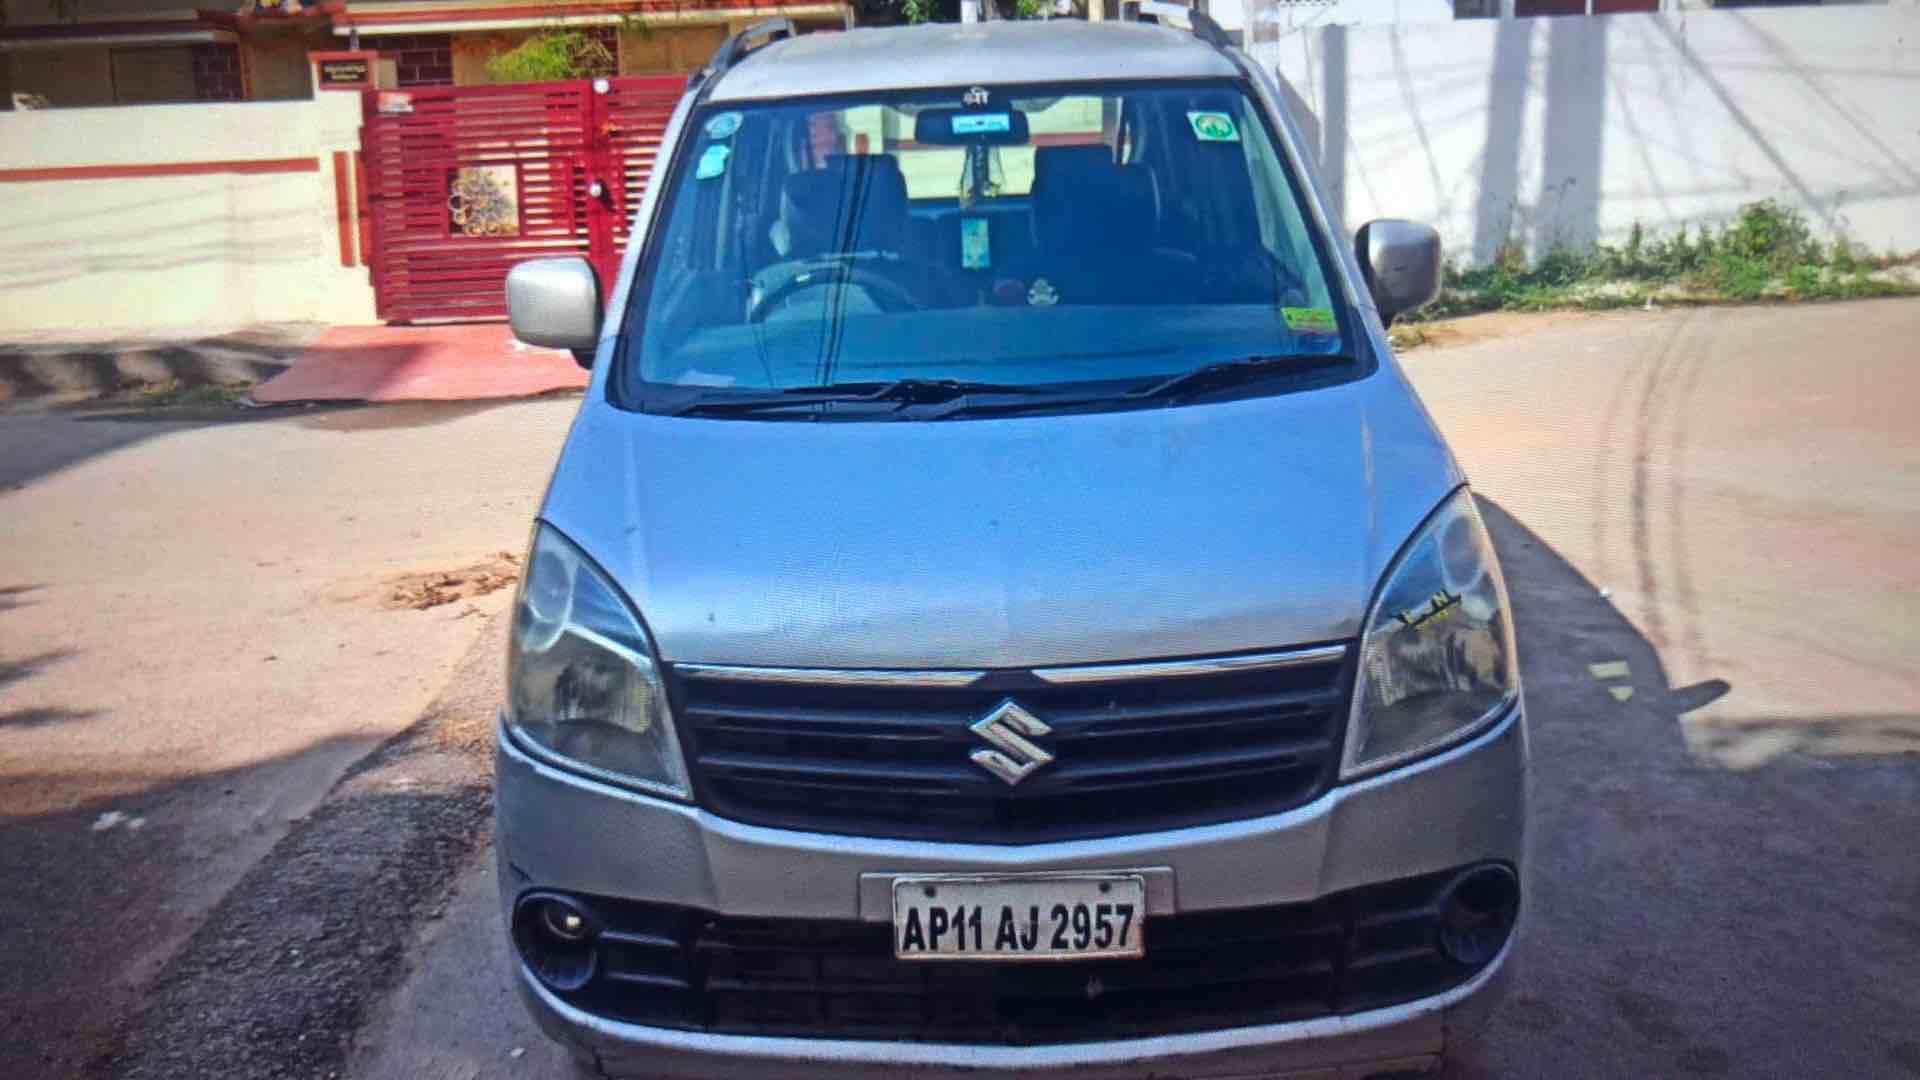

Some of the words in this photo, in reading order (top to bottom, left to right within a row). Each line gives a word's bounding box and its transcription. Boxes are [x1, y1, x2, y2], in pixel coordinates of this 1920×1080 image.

[902, 905, 982, 951] AP11
[995, 905, 1040, 950] AJ
[1050, 903, 1135, 950] 2957
